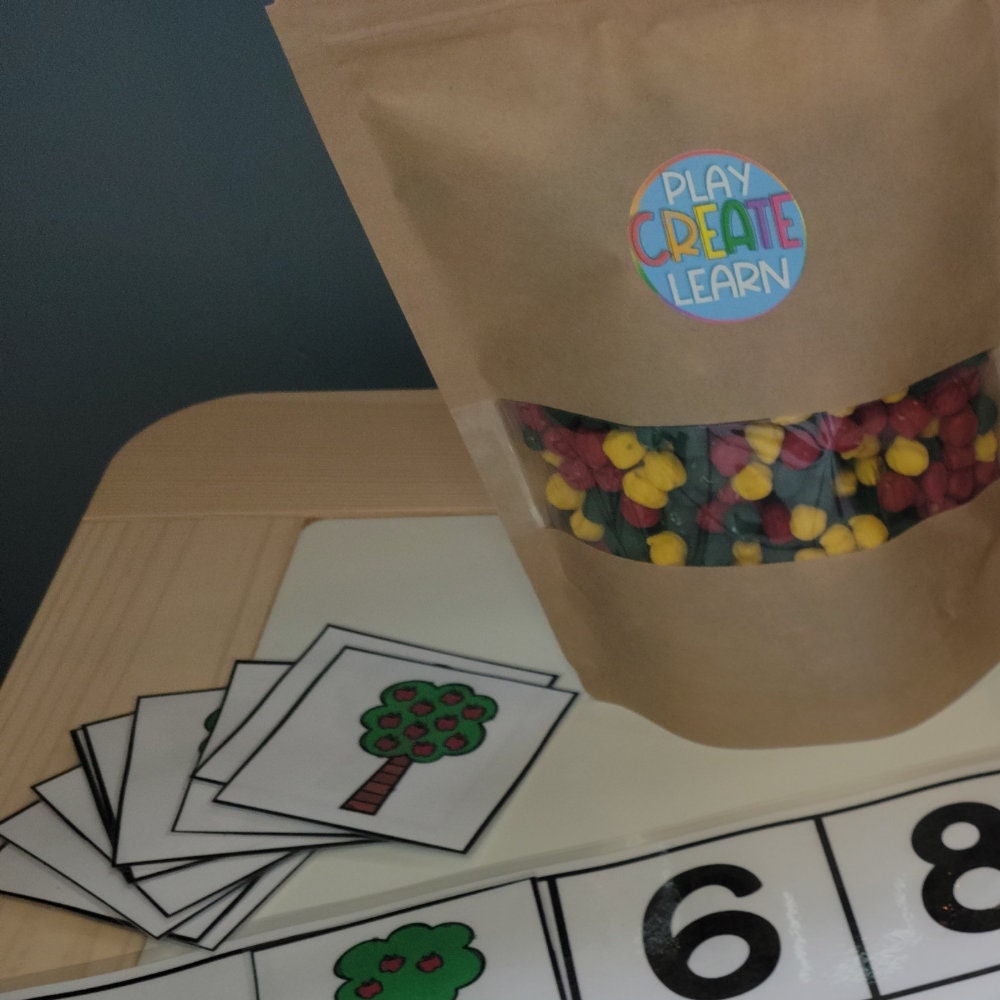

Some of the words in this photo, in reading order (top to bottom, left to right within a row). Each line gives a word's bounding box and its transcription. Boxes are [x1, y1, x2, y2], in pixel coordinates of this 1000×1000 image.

[661, 161, 752, 205] PLAY
[629, 193, 802, 268] CREATE
[667, 257, 790, 308] LEARN
[642, 863, 781, 1000] 6
